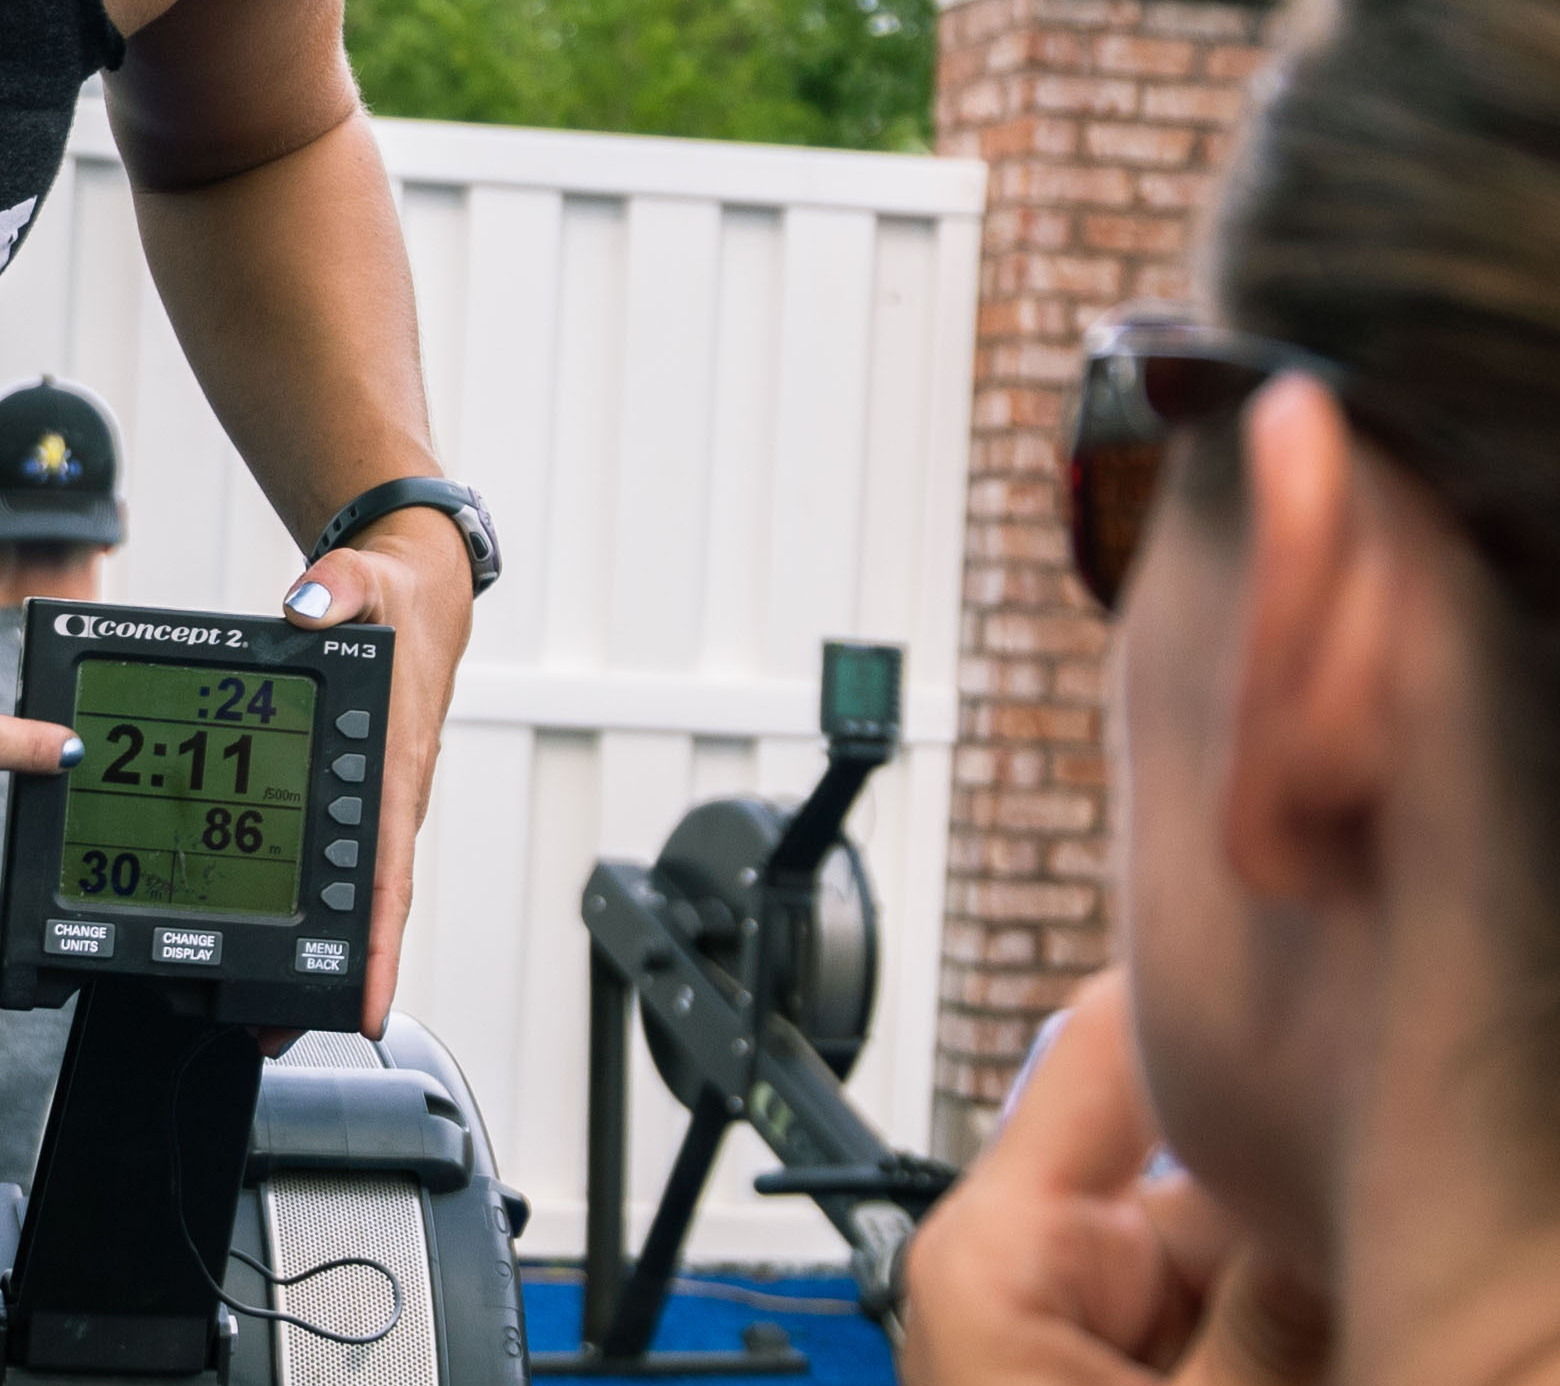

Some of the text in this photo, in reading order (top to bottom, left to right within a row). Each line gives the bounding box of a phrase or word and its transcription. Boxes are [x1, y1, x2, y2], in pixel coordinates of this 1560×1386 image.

[97, 619, 221, 646] concept
[323, 639, 377, 659] PM3
[101, 723, 253, 795] 2:11
[202, 808, 264, 854] 86
[78, 850, 141, 897] 30
[54, 923, 107, 939] CHANGE
[162, 931, 215, 948] CHANGE
[60, 938, 99, 953] UNITS
[162, 946, 214, 962] DISPLAY
[305, 941, 343, 956] MENU
[306, 957, 340, 972] BACK
[502, 1325, 523, 1359] 8
